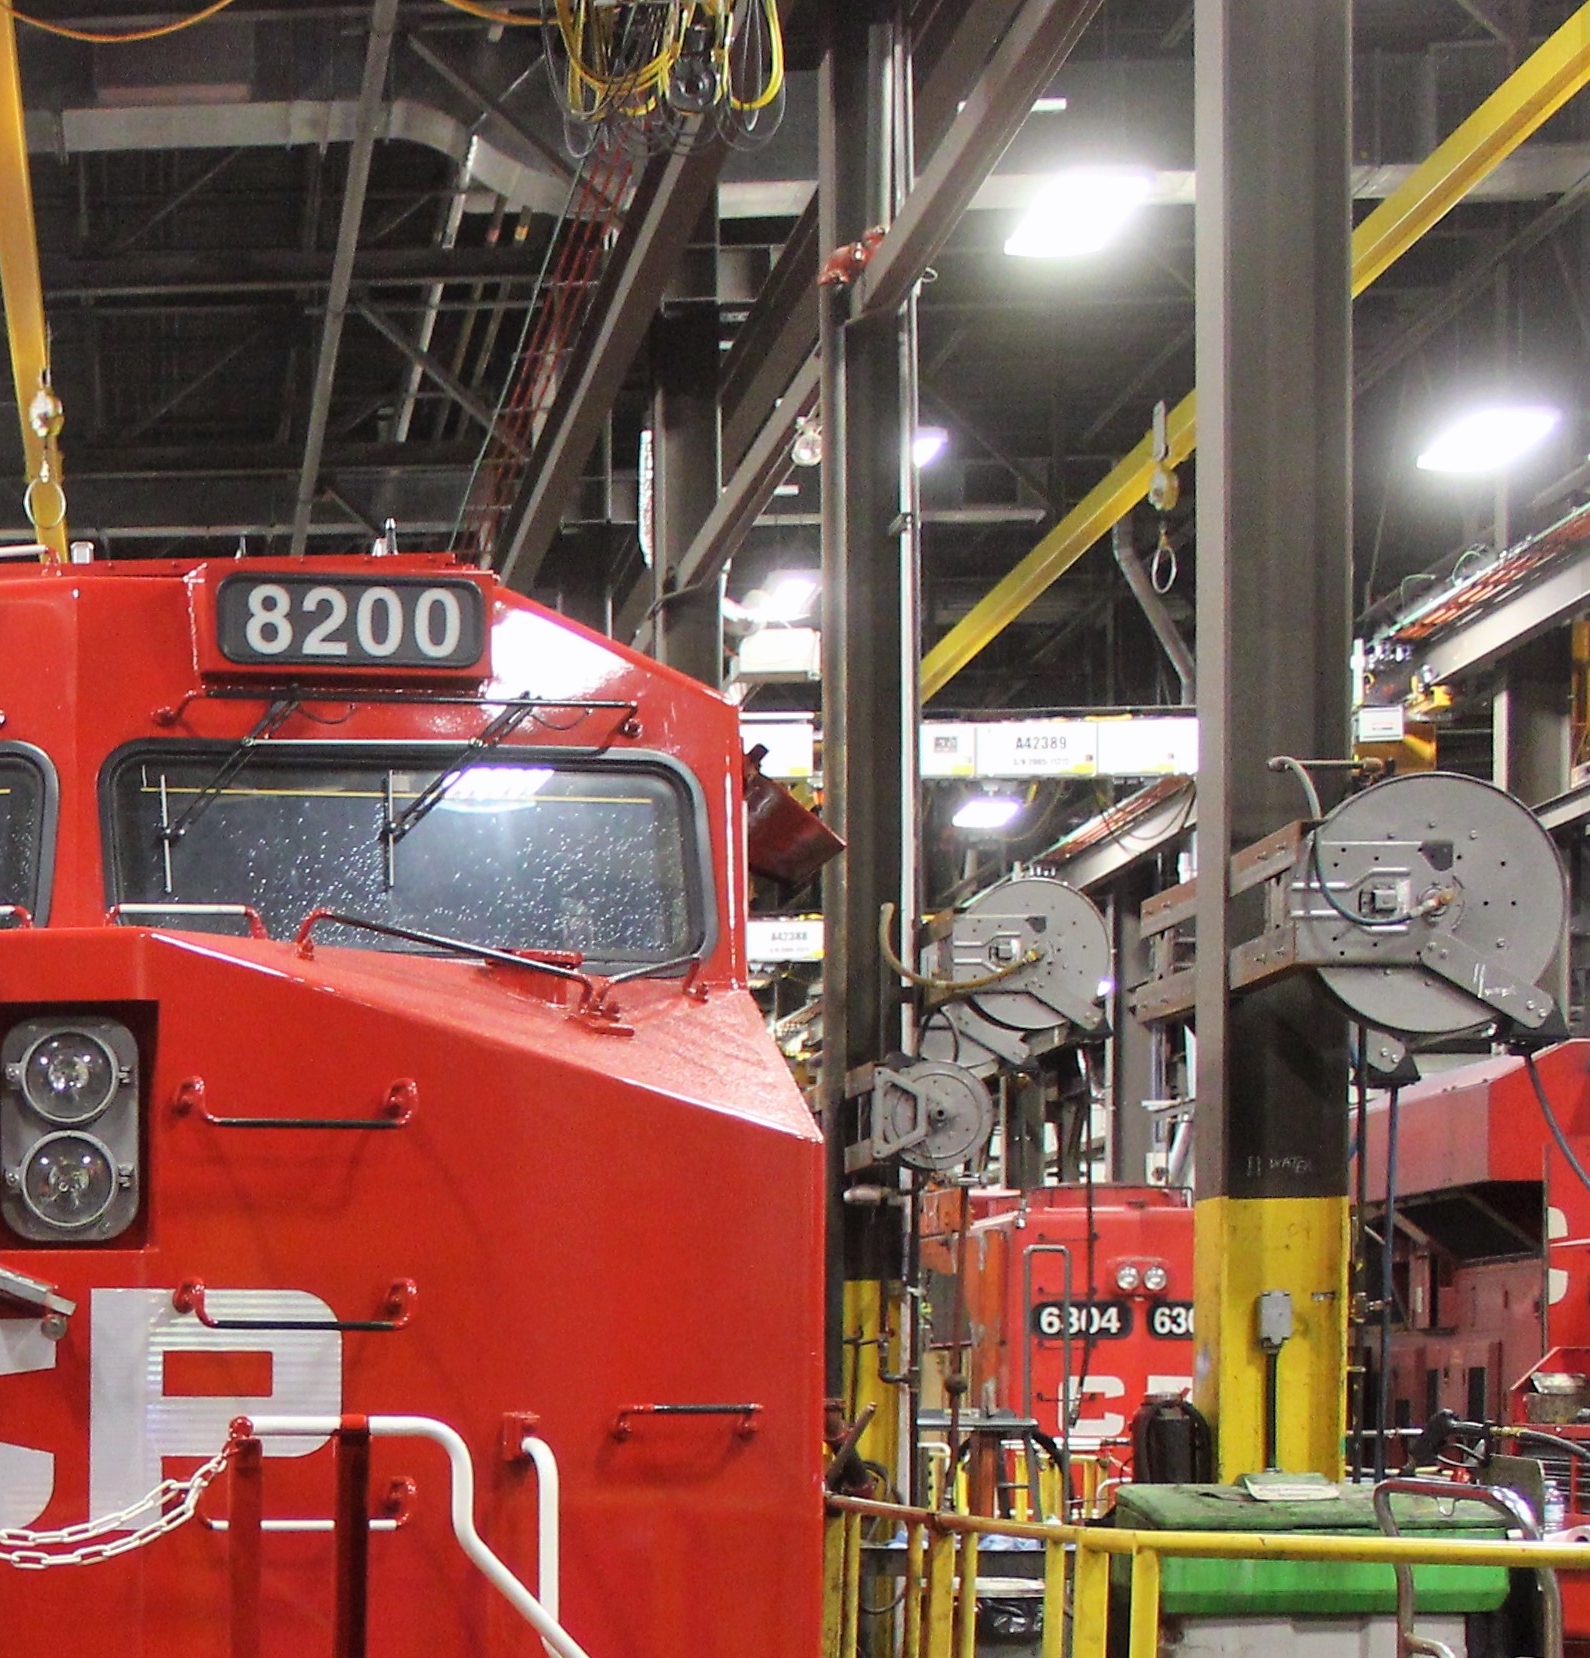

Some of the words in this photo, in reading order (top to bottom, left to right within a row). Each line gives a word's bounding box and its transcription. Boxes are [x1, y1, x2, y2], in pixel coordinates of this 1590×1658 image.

[245, 584, 462, 657] 8200
[1015, 736, 1067, 750] A42389
[1040, 1306, 1121, 1335] 6304
[1057, 1375, 1193, 1437] C
